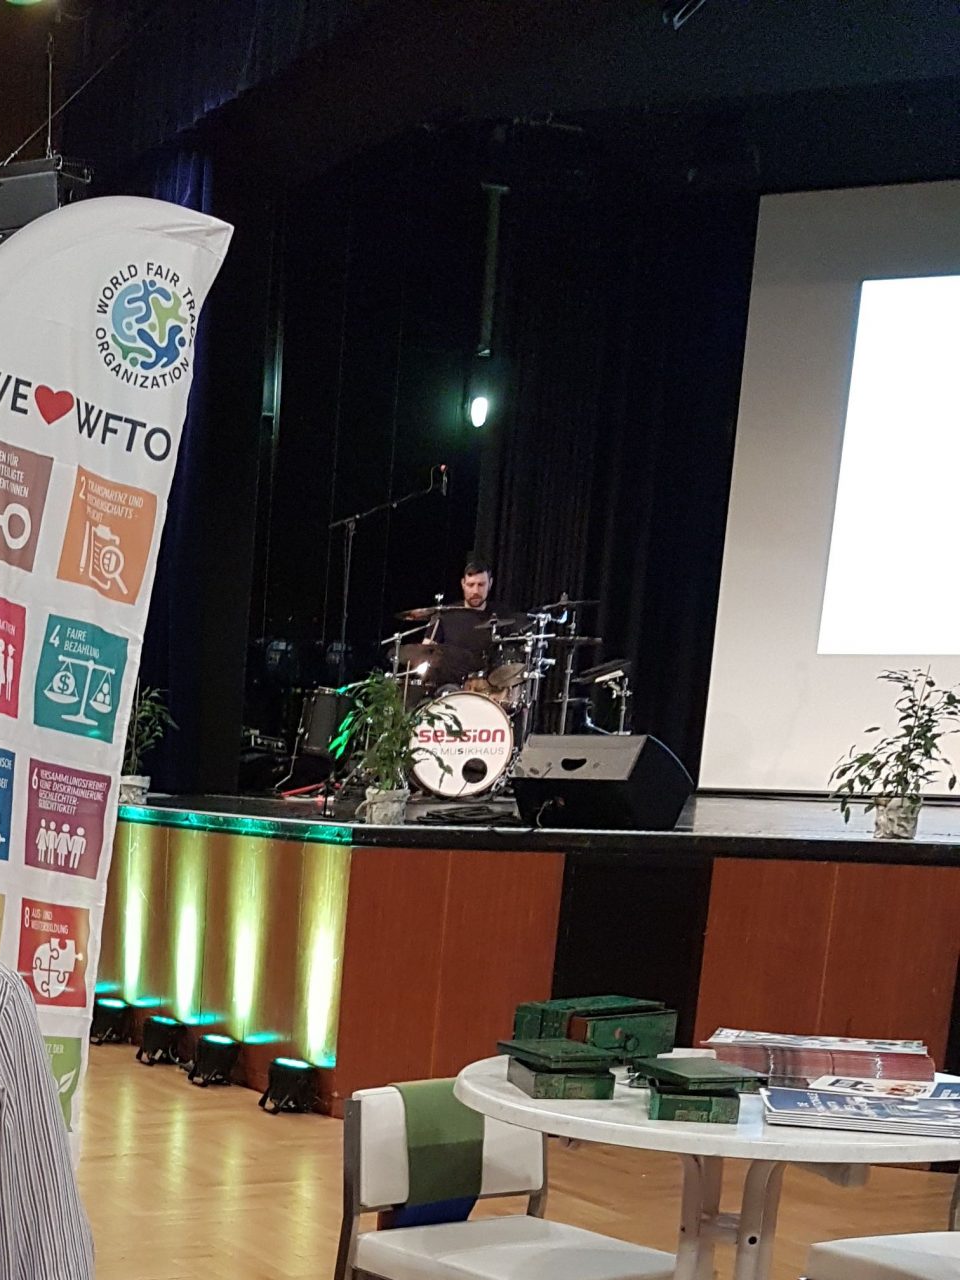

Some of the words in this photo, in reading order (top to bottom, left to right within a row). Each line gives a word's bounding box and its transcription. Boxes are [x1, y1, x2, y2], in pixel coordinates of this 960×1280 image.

[96, 264, 138, 315] WORLD
[146, 262, 180, 287] FAIR
[95, 327, 189, 389] ORGANIZATION
[76, 397, 172, 462] WFTO
[7, 452, 19, 467] FÜR
[79, 476, 86, 499] 2
[49, 624, 61, 648] 4
[66, 627, 87, 642] FAIRE
[31, 767, 38, 790] 6
[24, 906, 30, 928] 8
